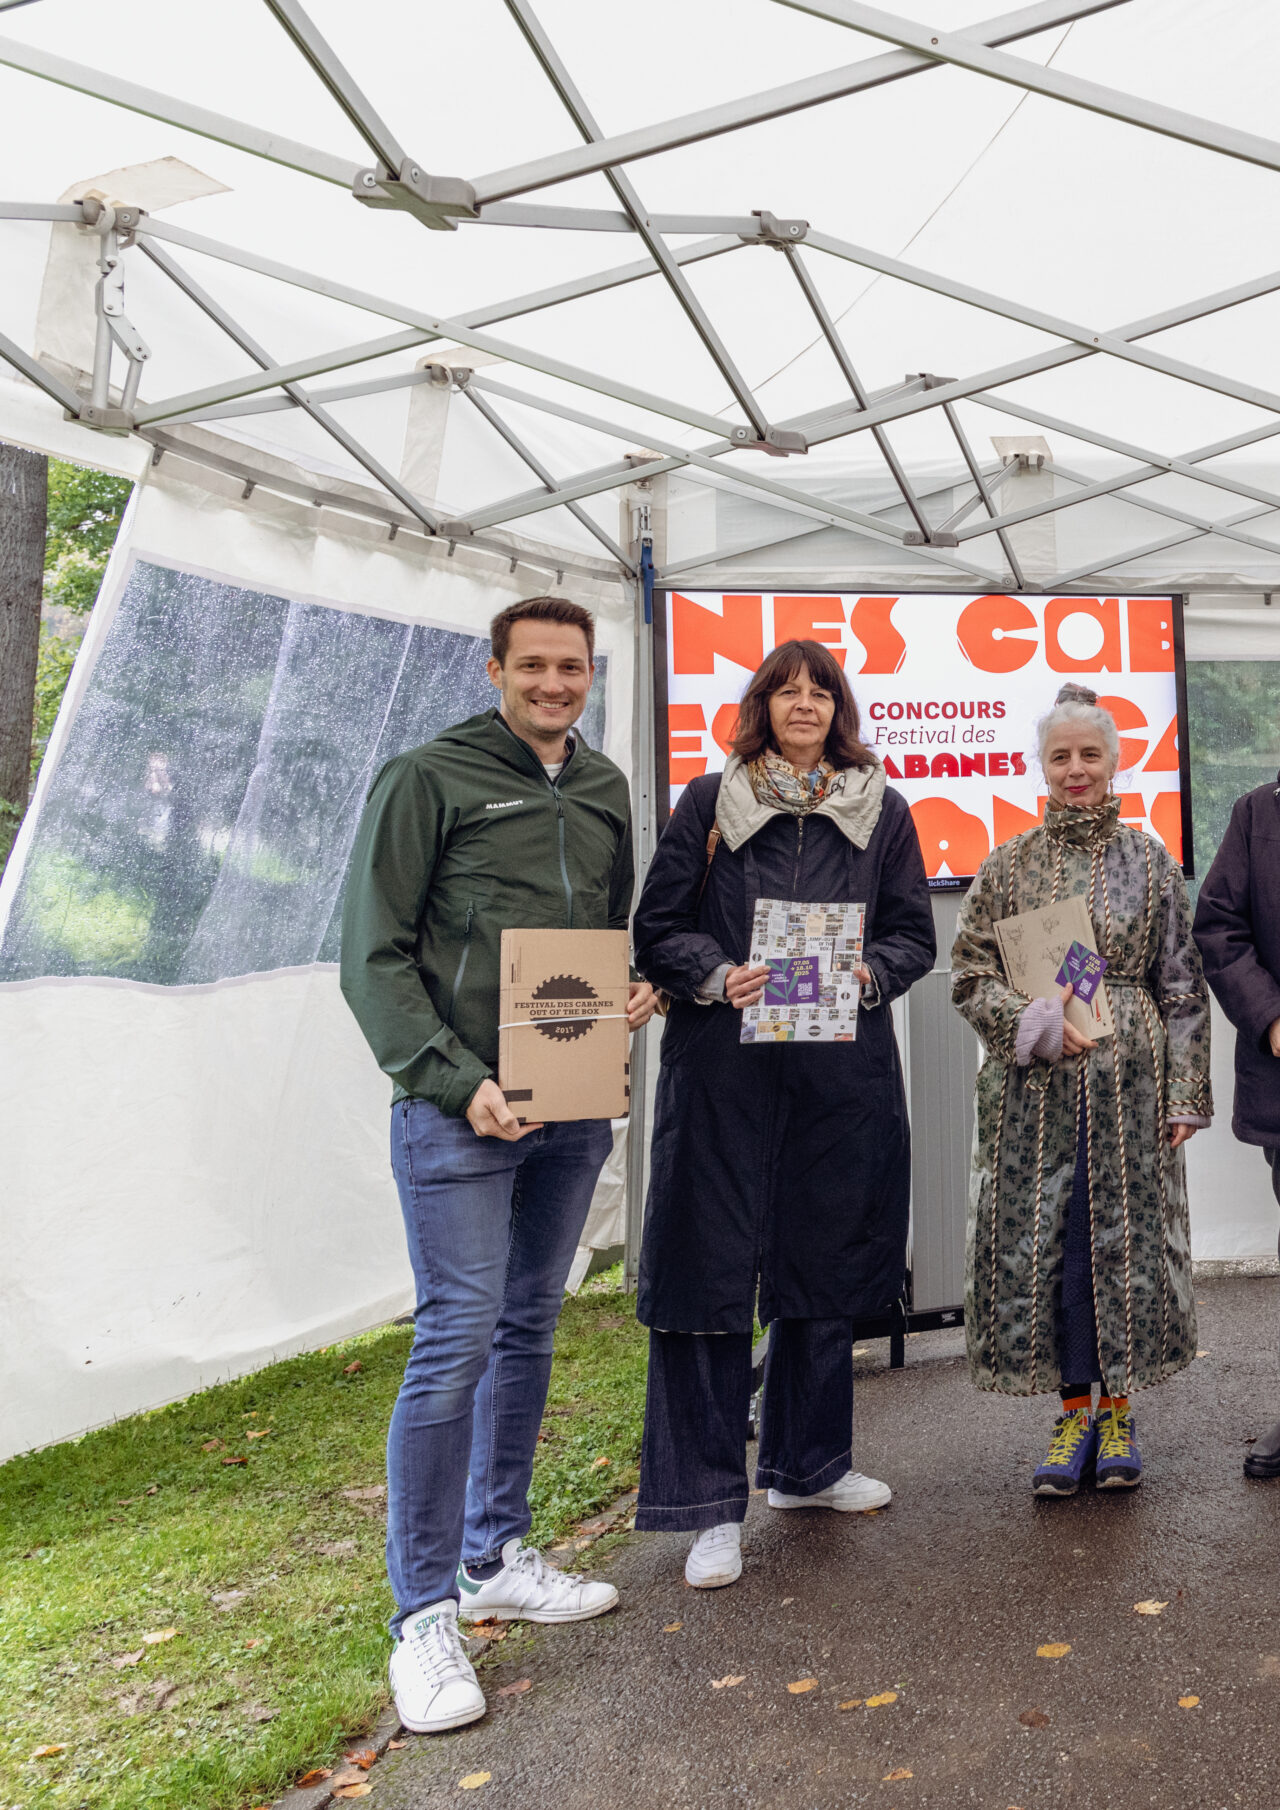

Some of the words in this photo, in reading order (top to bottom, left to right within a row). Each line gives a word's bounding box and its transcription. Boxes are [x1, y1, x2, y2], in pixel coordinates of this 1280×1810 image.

[869, 701, 1006, 720] CONCOURS
[874, 725, 956, 744] Festival
[962, 725, 996, 743] des
[882, 752, 1027, 779] ABANES
[486, 800, 523, 809] MAMMUT
[514, 1001, 556, 1009] FESTIVAL
[554, 1026, 574, 1034] 2017
